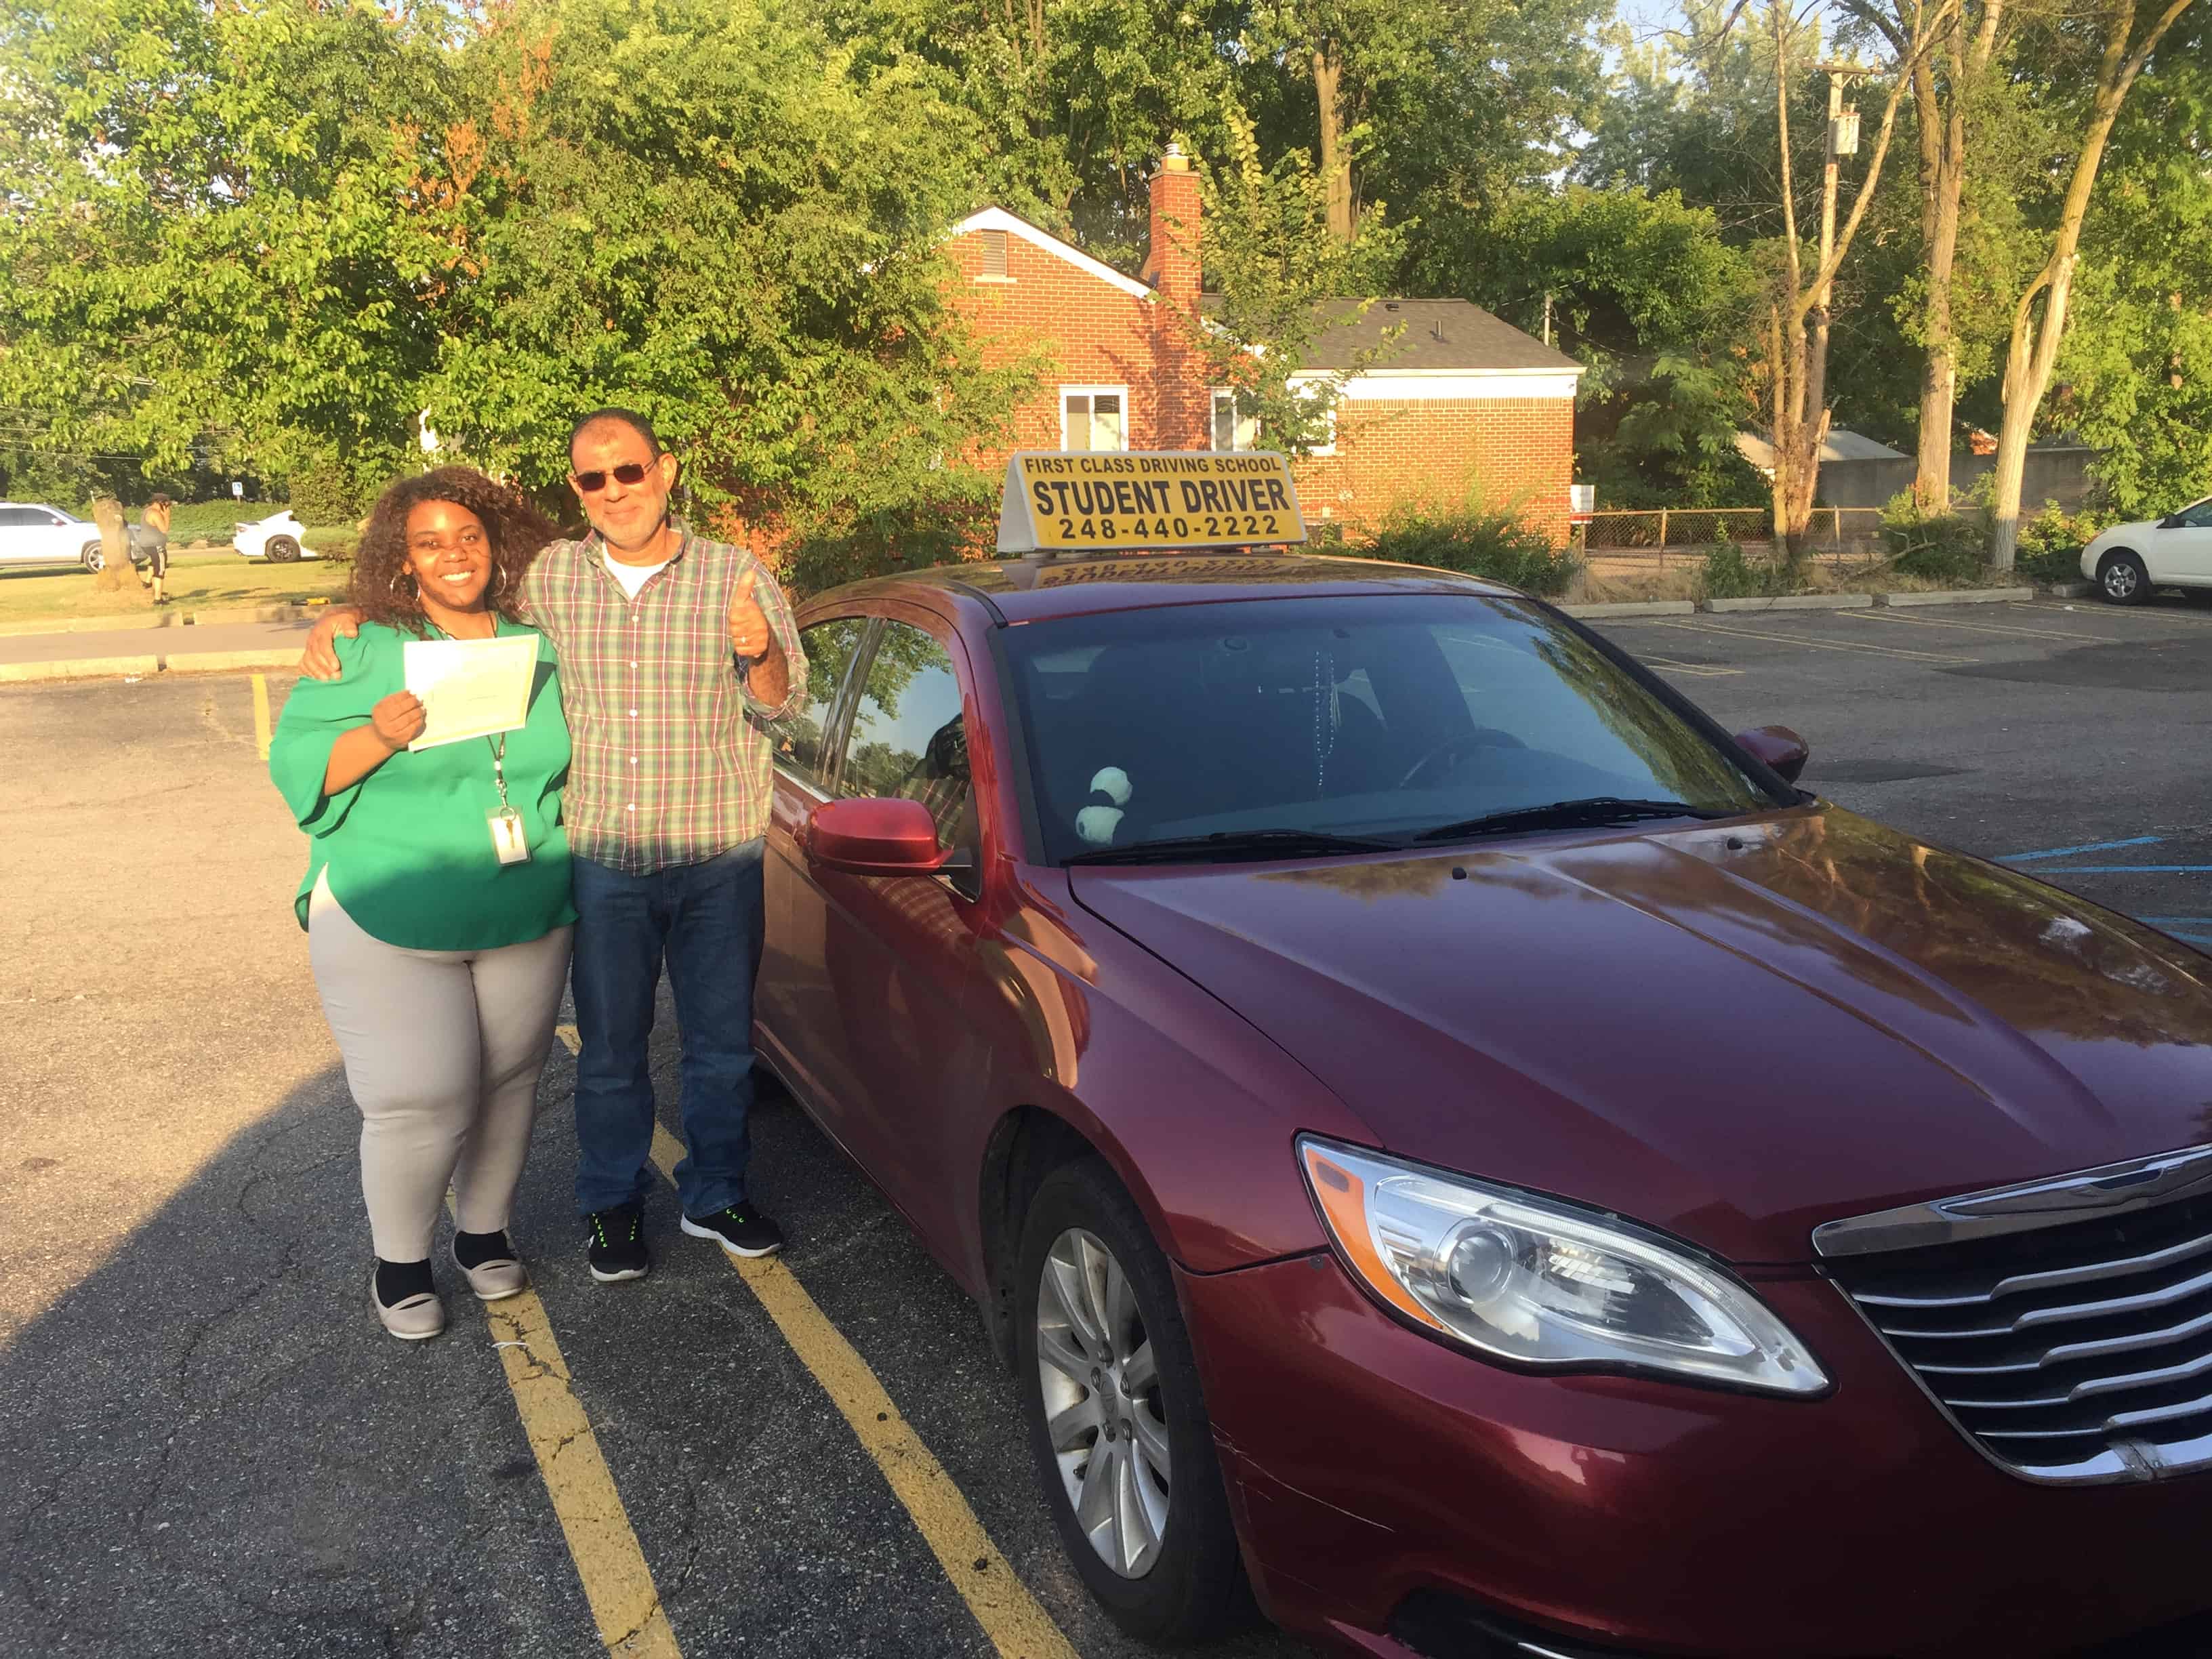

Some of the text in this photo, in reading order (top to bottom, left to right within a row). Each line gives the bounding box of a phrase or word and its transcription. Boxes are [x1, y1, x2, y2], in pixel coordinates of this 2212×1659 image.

[1025, 457, 1282, 473] FIRST CLASS DRIVING SCHOOL
[1033, 478, 1290, 515] STUDENT DRIVER
[1059, 514, 1279, 539] 248-440-2222
